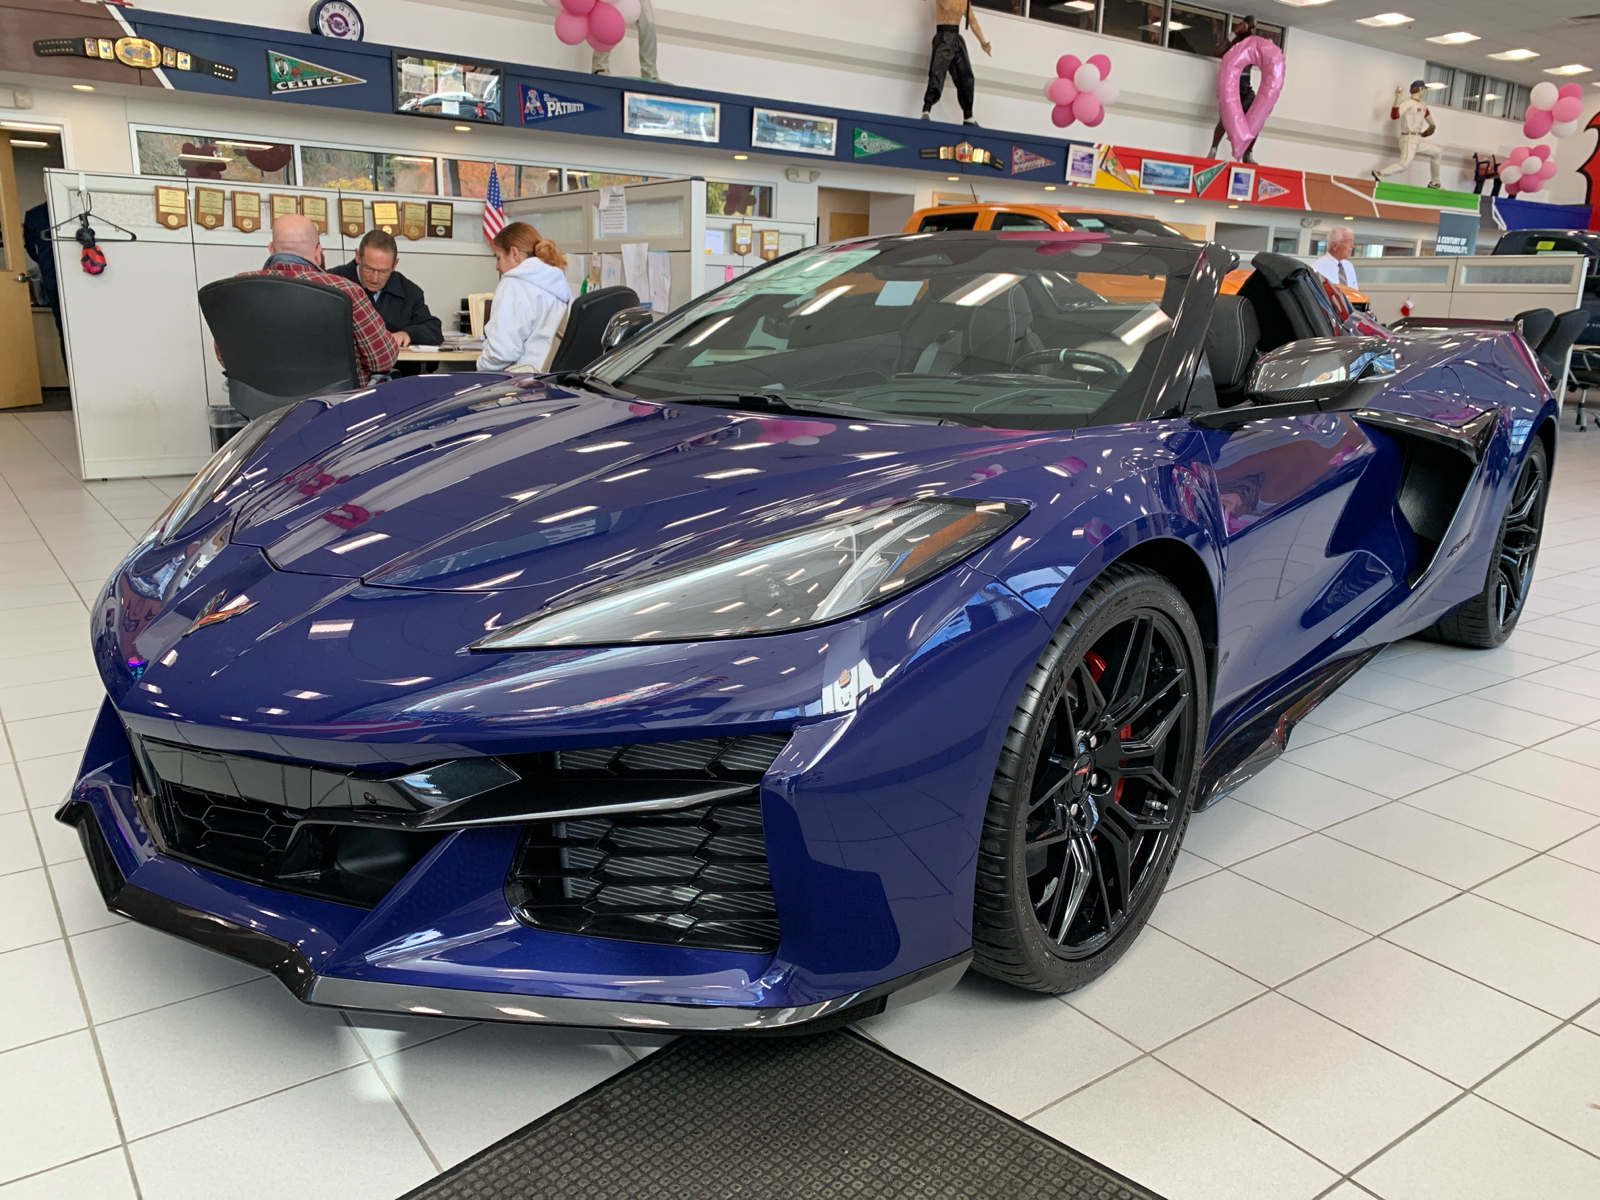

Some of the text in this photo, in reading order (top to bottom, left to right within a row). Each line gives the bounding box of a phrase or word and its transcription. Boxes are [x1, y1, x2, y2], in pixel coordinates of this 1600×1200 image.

[276, 75, 343, 90] CELTICS
[546, 101, 584, 117] PATRIOTS
[1441, 236, 1460, 245] CENTURY
[1027, 675, 1064, 775] MICHELIN
